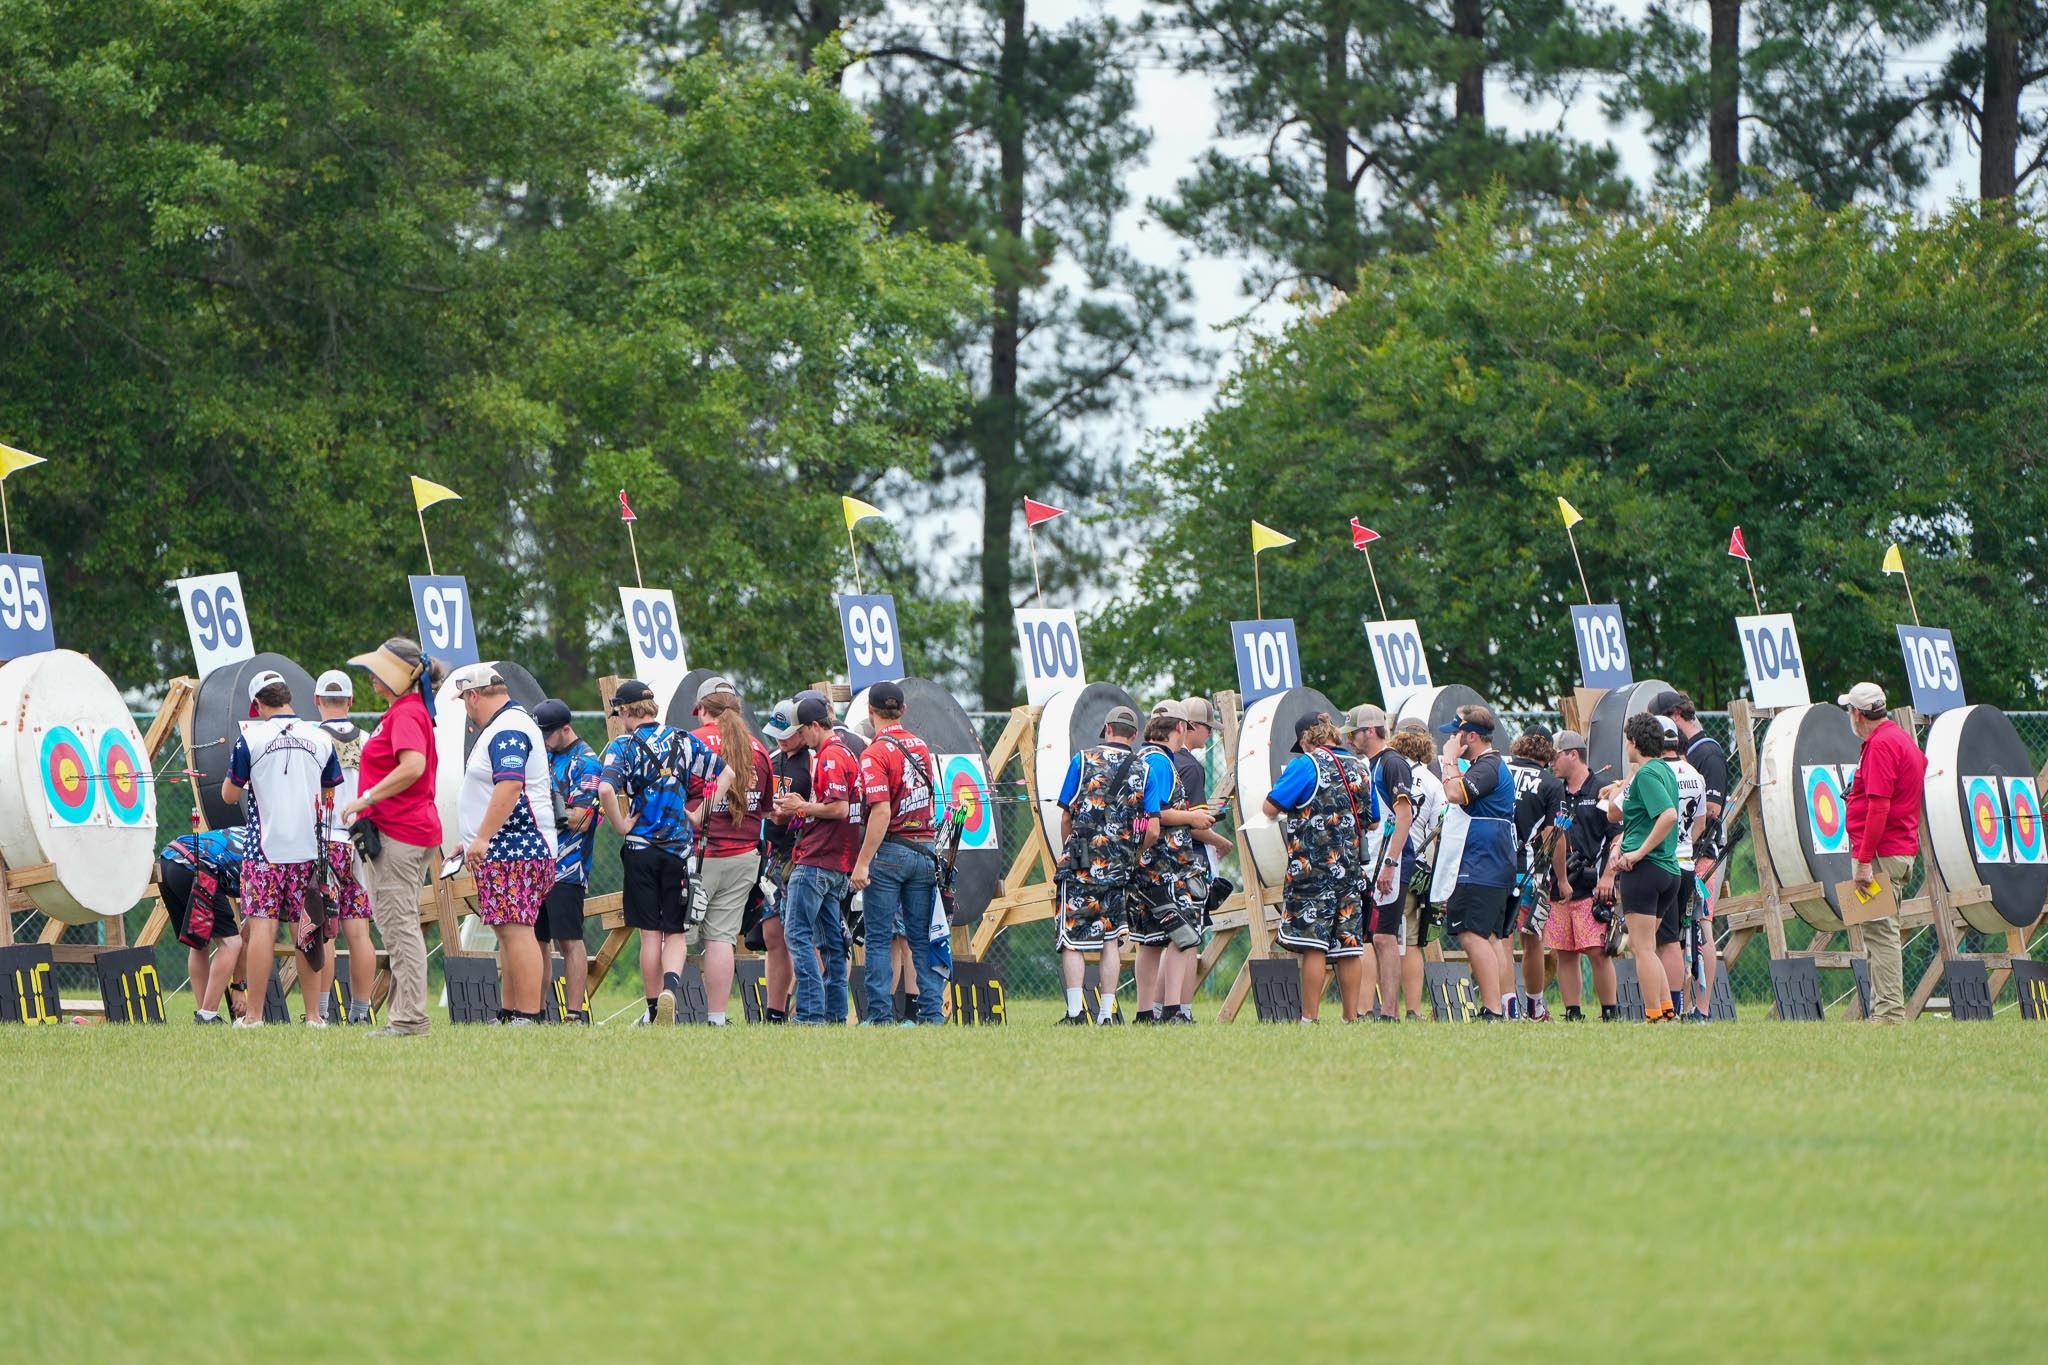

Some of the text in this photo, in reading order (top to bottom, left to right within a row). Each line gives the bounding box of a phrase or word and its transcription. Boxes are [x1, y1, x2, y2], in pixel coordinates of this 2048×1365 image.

[0, 564, 47, 632] 95
[191, 586, 243, 651] 96
[423, 586, 463, 649] 97
[633, 600, 678, 661] 98
[849, 605, 895, 667] 99
[1023, 621, 1078, 679] 100
[1375, 632, 1427, 688] 102
[1578, 615, 1625, 672] 103
[1744, 627, 1800, 681] 104
[1243, 631, 1293, 691] 101
[1905, 636, 1958, 691] 105
